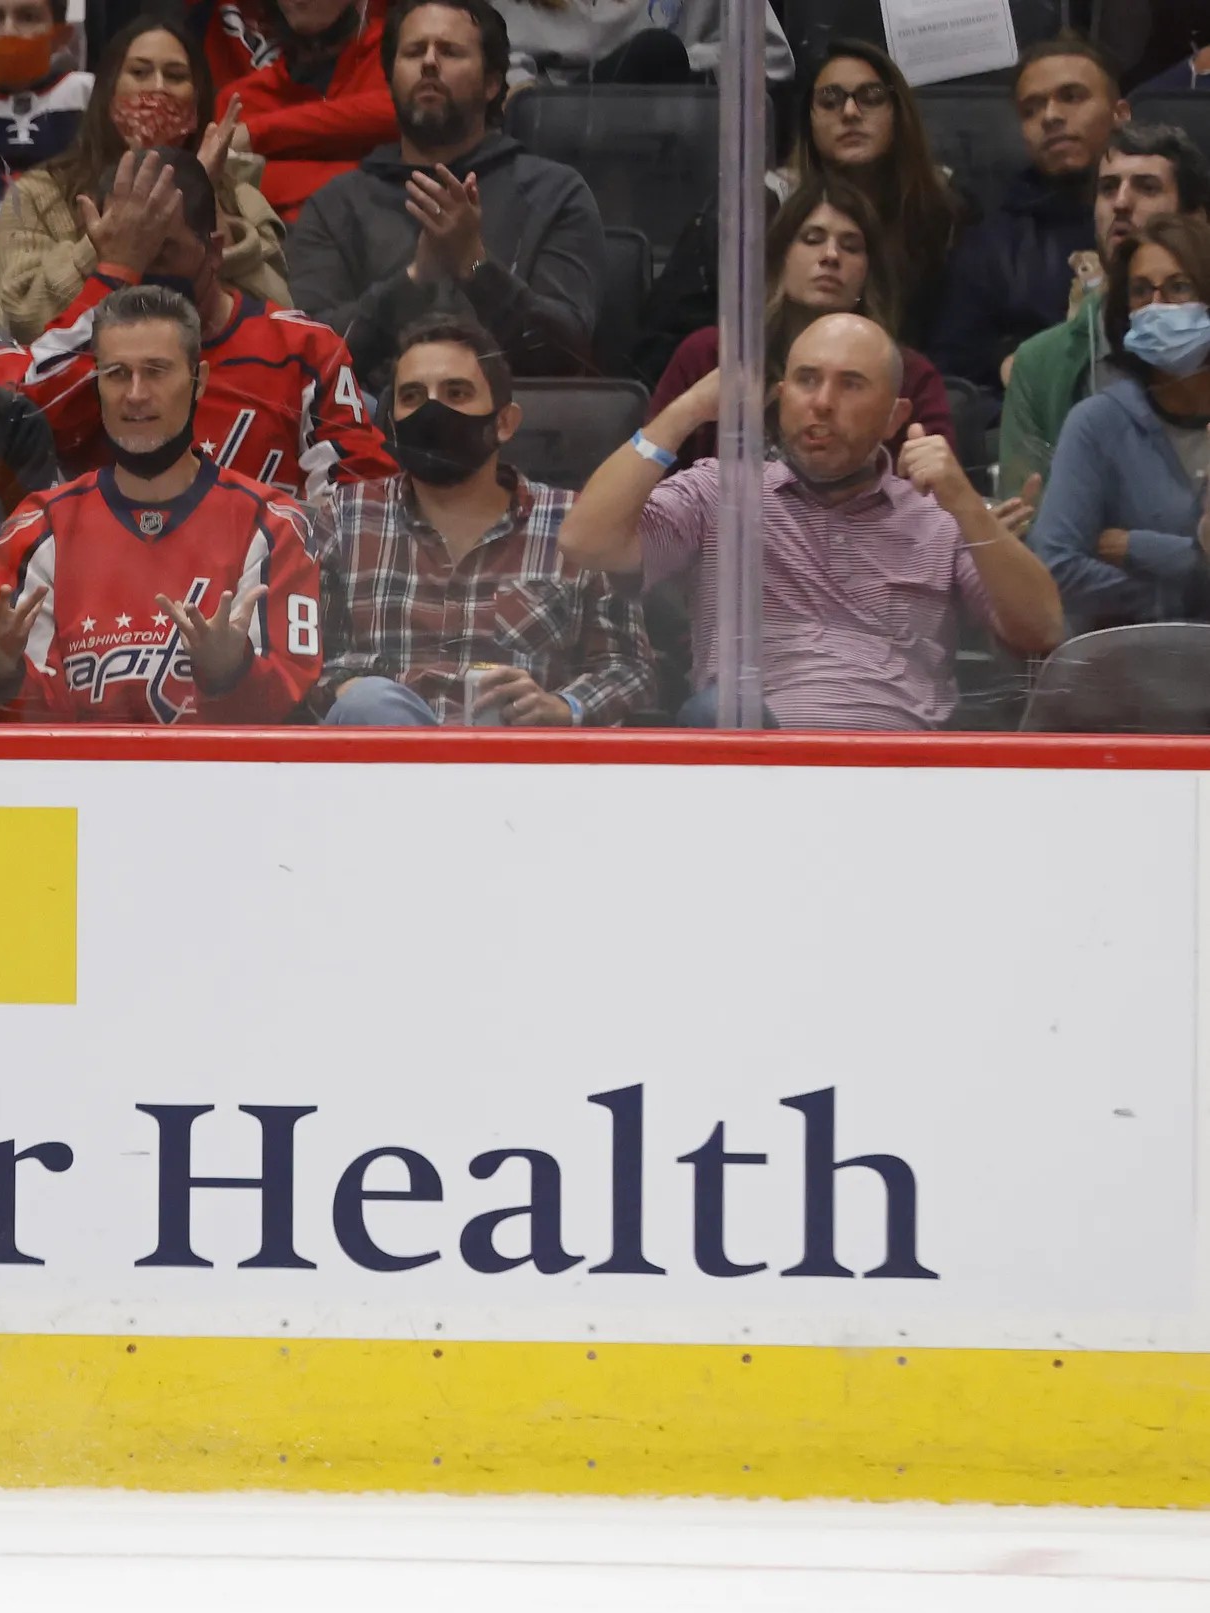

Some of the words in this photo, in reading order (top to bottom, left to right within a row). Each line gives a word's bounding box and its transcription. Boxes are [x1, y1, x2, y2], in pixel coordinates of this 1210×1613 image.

[335, 365, 363, 424] 4
[68, 630, 166, 653] WASHINGTON
[287, 594, 320, 656] 8
[134, 1083, 941, 1281] Health
